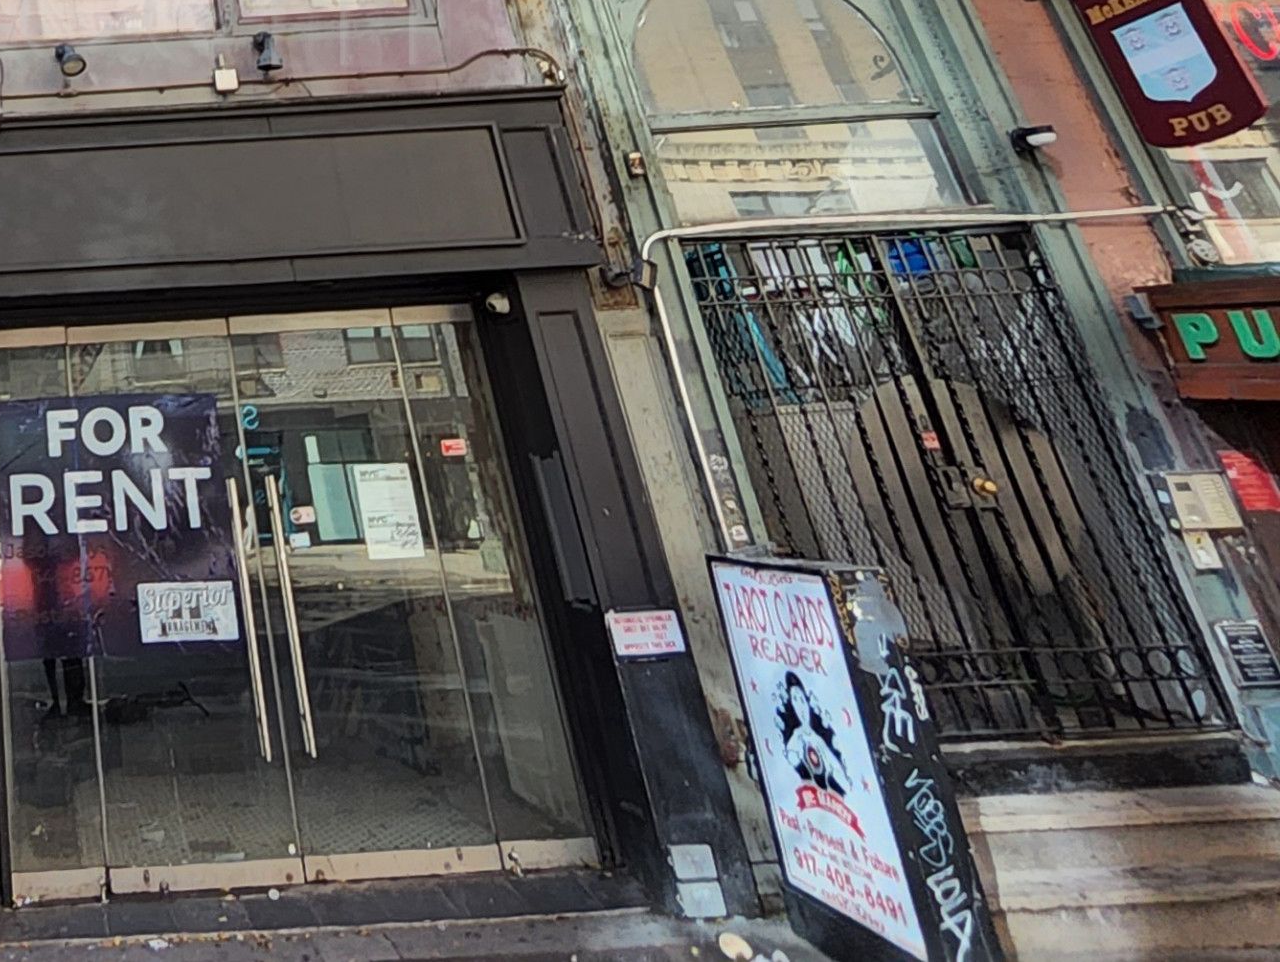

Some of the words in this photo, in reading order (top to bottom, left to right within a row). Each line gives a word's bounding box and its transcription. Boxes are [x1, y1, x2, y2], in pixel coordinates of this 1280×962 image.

[1169, 103, 1233, 137] PUB
[46, 405, 168, 458] FOR
[9, 467, 212, 537] RENT
[722, 581, 777, 637] TAROT
[773, 590, 835, 650] CARDS
[748, 633, 828, 677] READER
